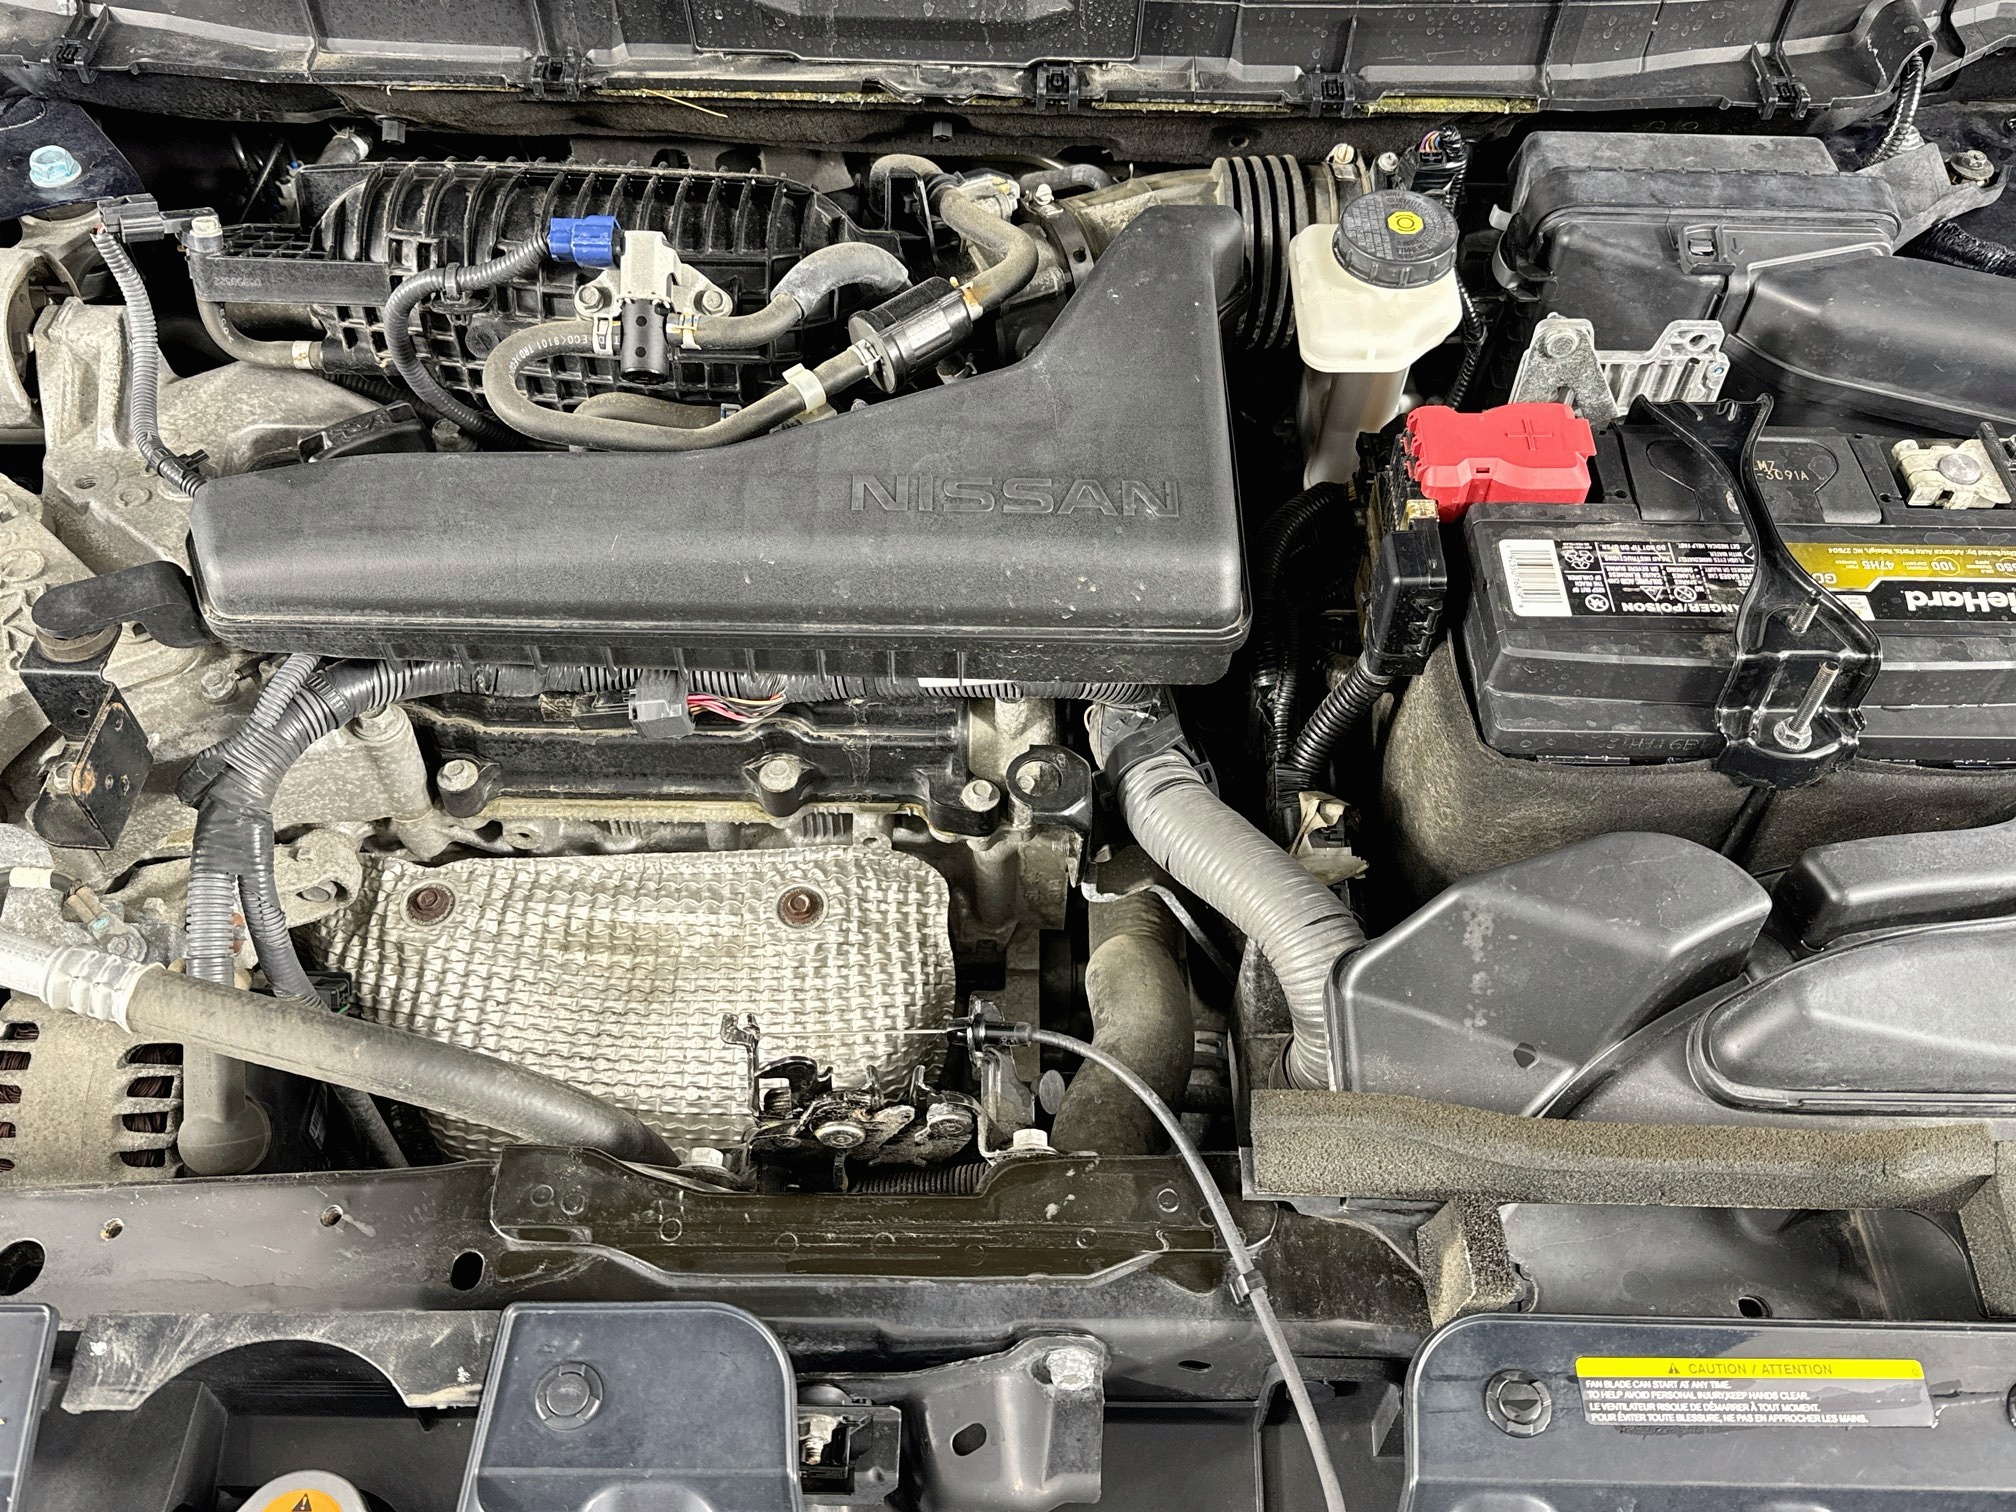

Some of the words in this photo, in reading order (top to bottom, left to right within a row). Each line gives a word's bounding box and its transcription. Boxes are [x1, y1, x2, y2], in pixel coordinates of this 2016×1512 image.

[851, 474, 1180, 517] NISSAN
[1861, 560, 1895, 571] 47H5
[1931, 561, 1955, 571] 100
[1621, 602, 1740, 613] ANGER/POISON
[1688, 1363, 1747, 1375] CAUTION
[1762, 1364, 1832, 1375] ATTENTION
[1585, 1380, 1603, 1388] FAN
[1603, 1380, 1632, 1388] BLADE
[1632, 1380, 1652, 1388] CAN
[1652, 1380, 1678, 1388] START
[1680, 1380, 1690, 1389] AT
[1691, 1380, 1708, 1389] ANY
[1709, 1381, 1732, 1389] TIME.
[1586, 1390, 1600, 1399] TO
[1601, 1390, 1623, 1399] HELP
[1624, 1391, 1650, 1399] AVOID
[1651, 1391, 1697, 1399] PERSONAL
[1748, 1391, 1779, 1400] HANDS
[1779, 1392, 1810, 1400] CLEAR.
[1589, 1402, 1601, 1411] LE
[1601, 1402, 1656, 1411] VENTILATEUR
[1656, 1403, 1689, 1411] RISQUE
[1690, 1403, 1702, 1411] DE
[1703, 1401, 1749, 1411] DÉMARRER
[1758, 1403, 1780, 1412] TOUT
[1781, 1403, 1821, 1412] MOMENT.
[1591, 1413, 1617, 1422] POUR
[1617, 1411, 1646, 1422] ÉVITER
[1647, 1413, 1675, 1422] TOUTE
[1675, 1414, 1723, 1423] BLESSURE,
[1723, 1414, 1736, 1422] NE
[1736, 1414, 1754, 1422] PAS
[1754, 1414, 1767, 1423] EN
[1768, 1414, 1821, 1423] APPROCHER
[1822, 1414, 1838, 1423] LES
[1839, 1414, 1868, 1423] MAINS.
